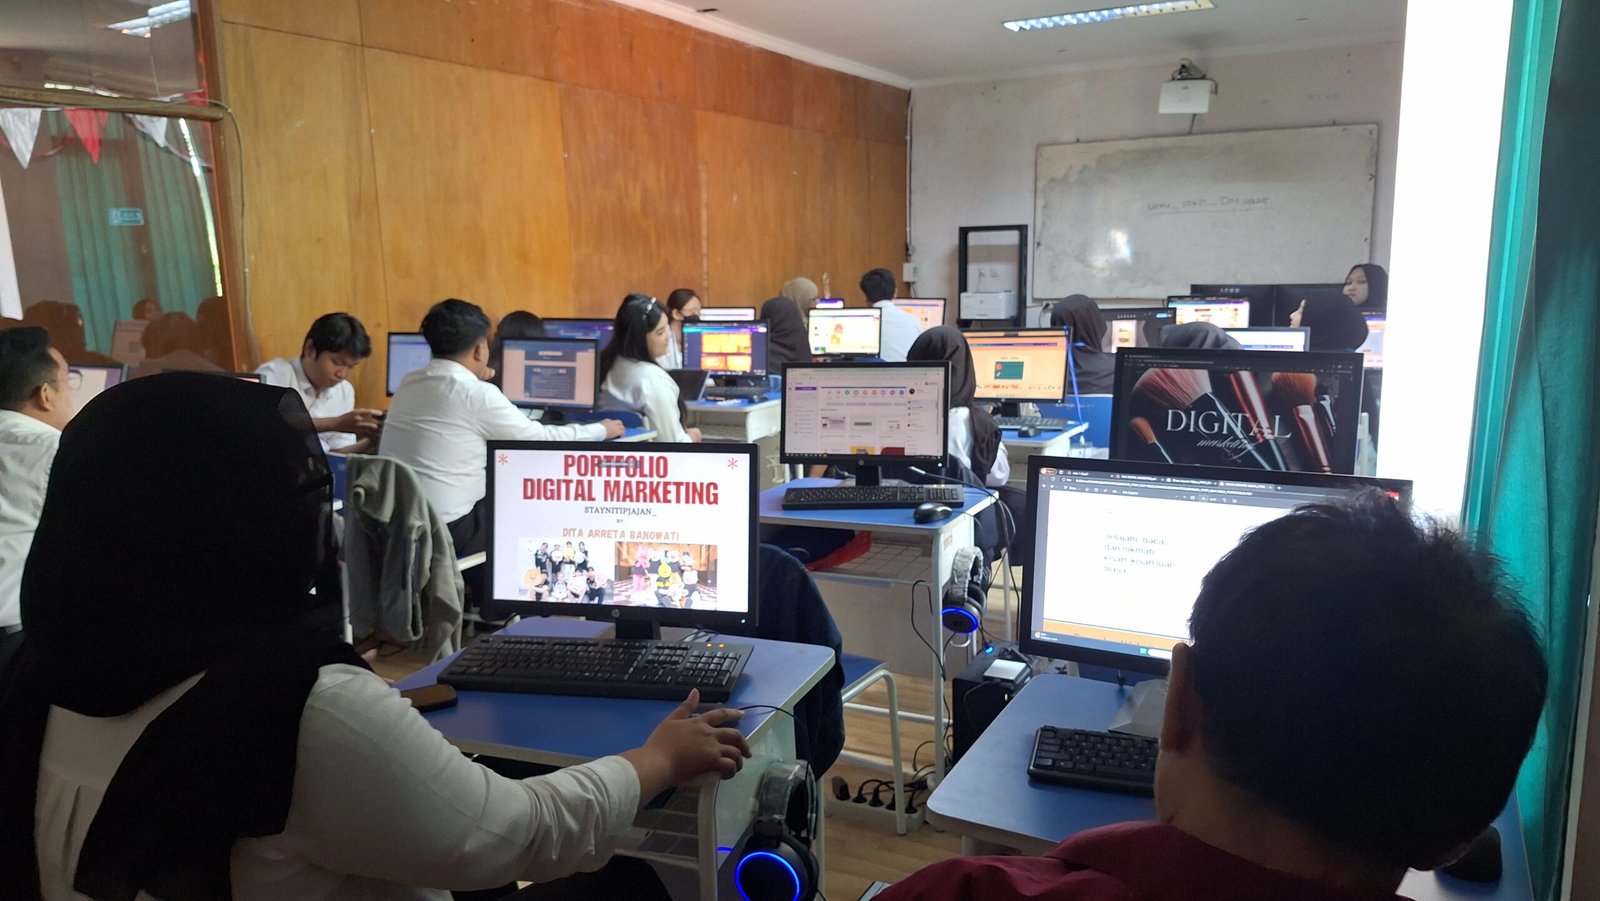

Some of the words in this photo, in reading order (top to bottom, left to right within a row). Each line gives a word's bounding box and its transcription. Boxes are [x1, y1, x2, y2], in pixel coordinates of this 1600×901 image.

[1166, 408, 1292, 439] DIGITAL
[563, 454, 669, 478] PORTFOLIO
[522, 477, 596, 501] DIGITAL
[603, 480, 719, 505] MARKETING
[562, 527, 584, 538] DITA
[587, 529, 626, 540] ARRETA
[629, 530, 680, 541] BANOWATI
